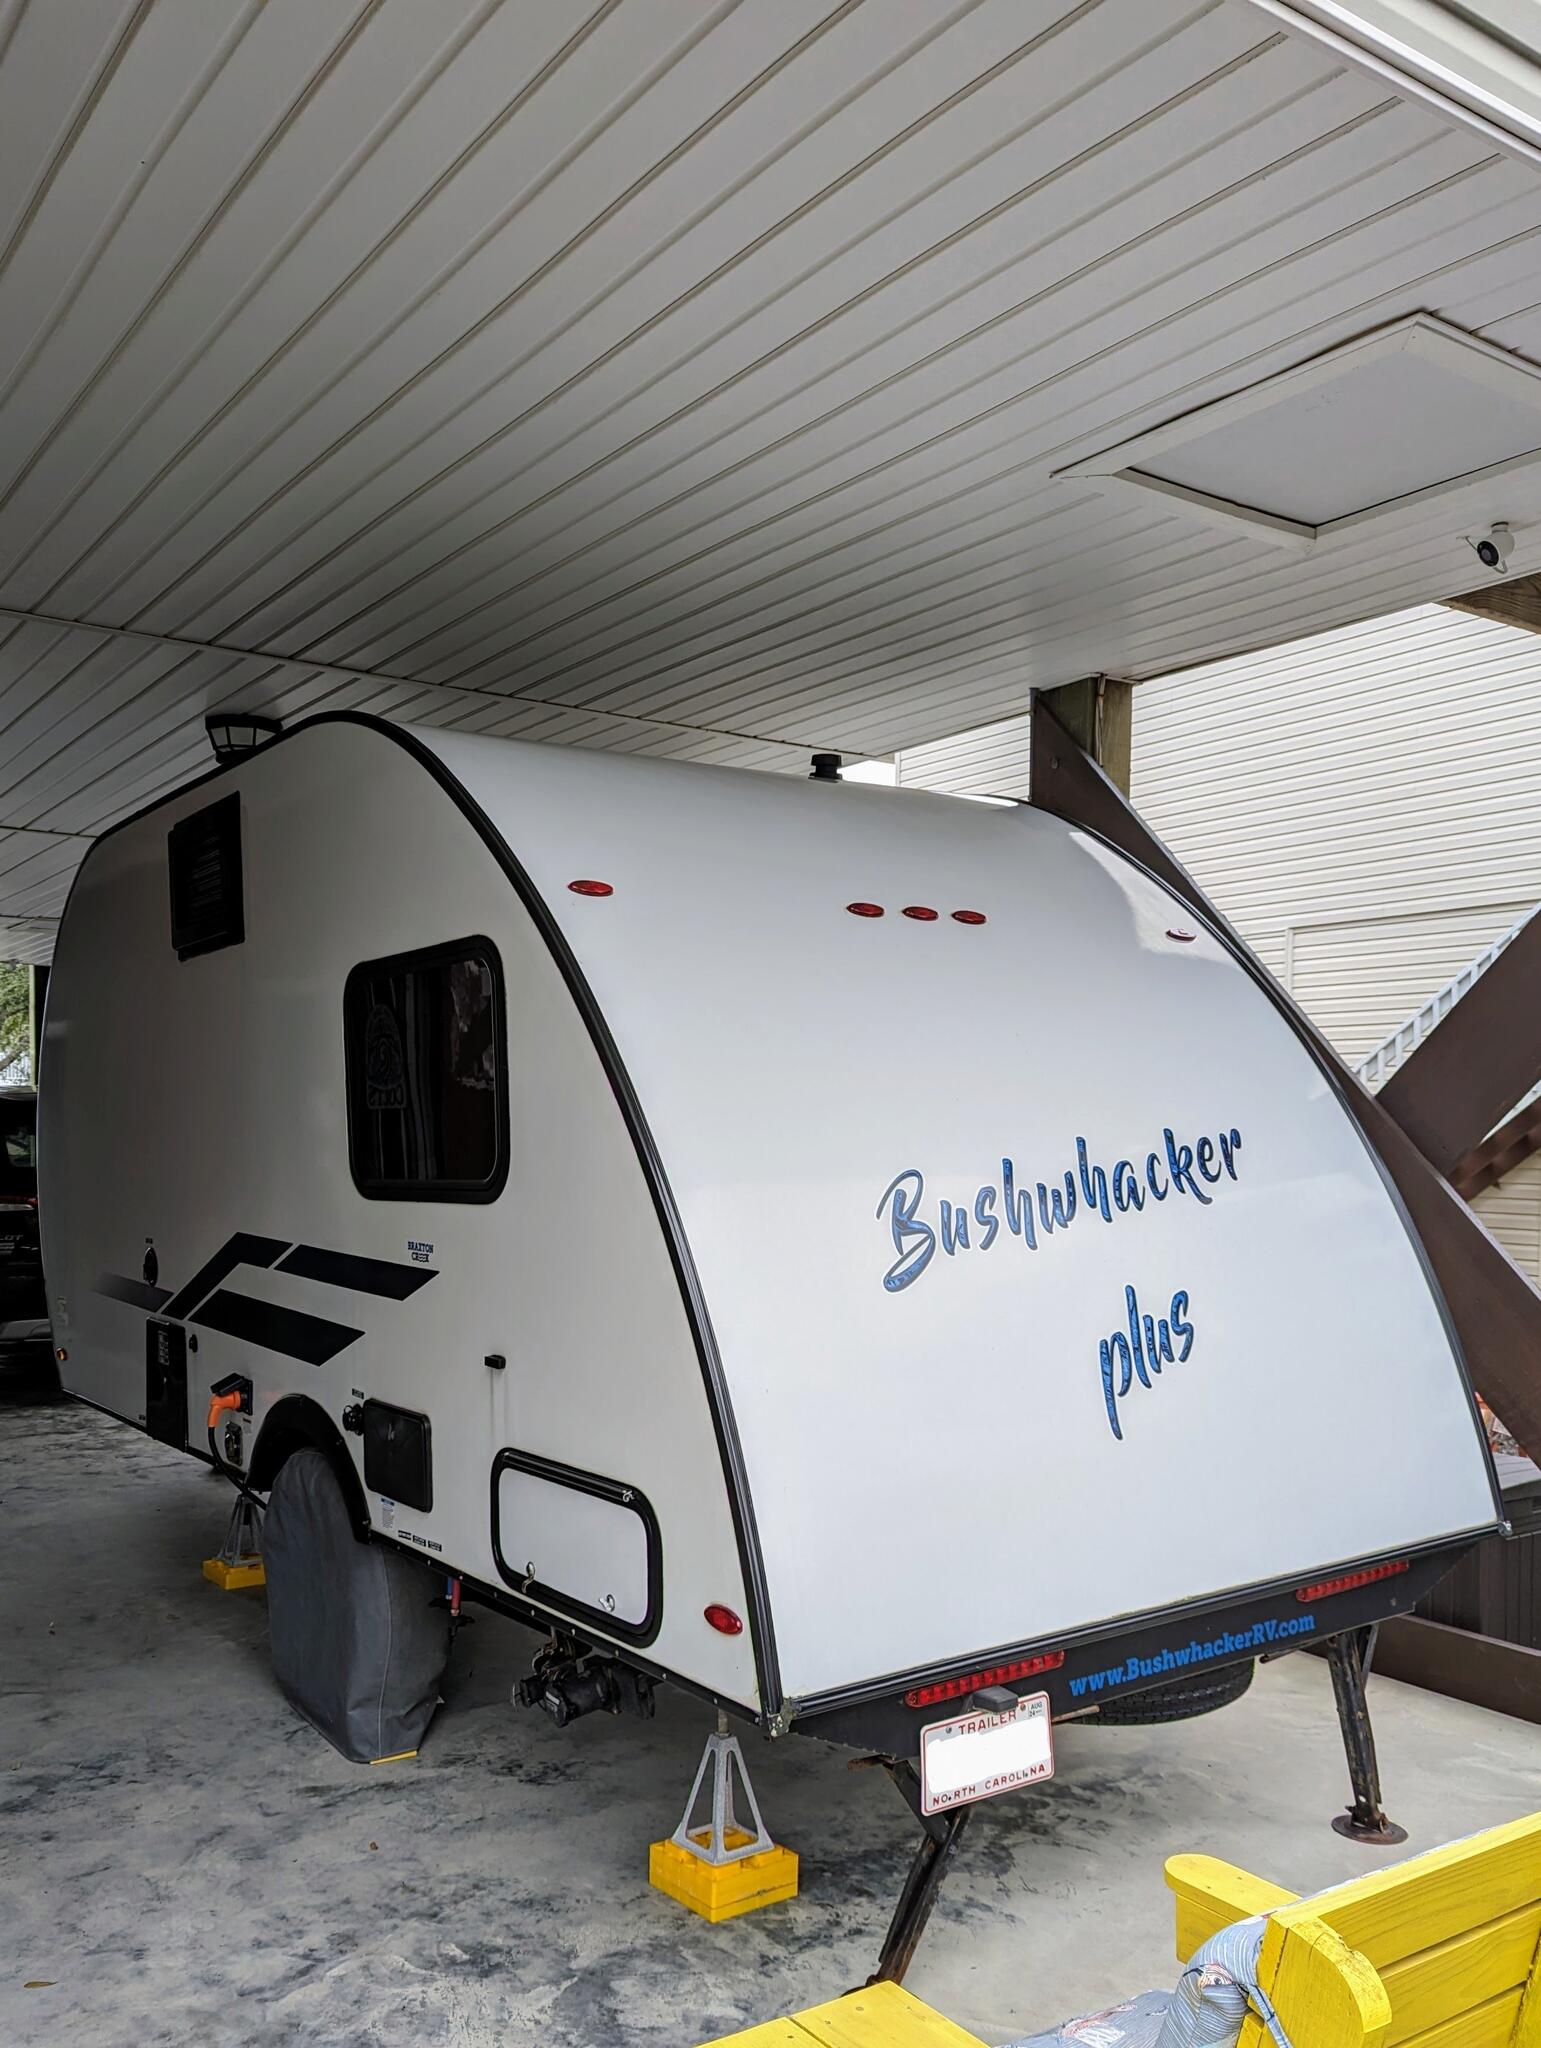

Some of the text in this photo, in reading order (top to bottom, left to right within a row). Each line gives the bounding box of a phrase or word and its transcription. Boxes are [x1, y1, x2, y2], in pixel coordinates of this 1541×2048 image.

[876, 1127, 1241, 1292] Bushwhacker
[408, 1241, 433, 1253] BRAXTON
[411, 1252, 429, 1262] CREEK
[1100, 1284, 1194, 1440] plus
[1069, 1614, 1316, 1696] www.BushwhackerRV.com
[958, 1709, 1017, 1735] TRAILER
[1030, 1701, 1043, 1710] AUG
[933, 1763, 1045, 1806] NORTH CAROLINA
